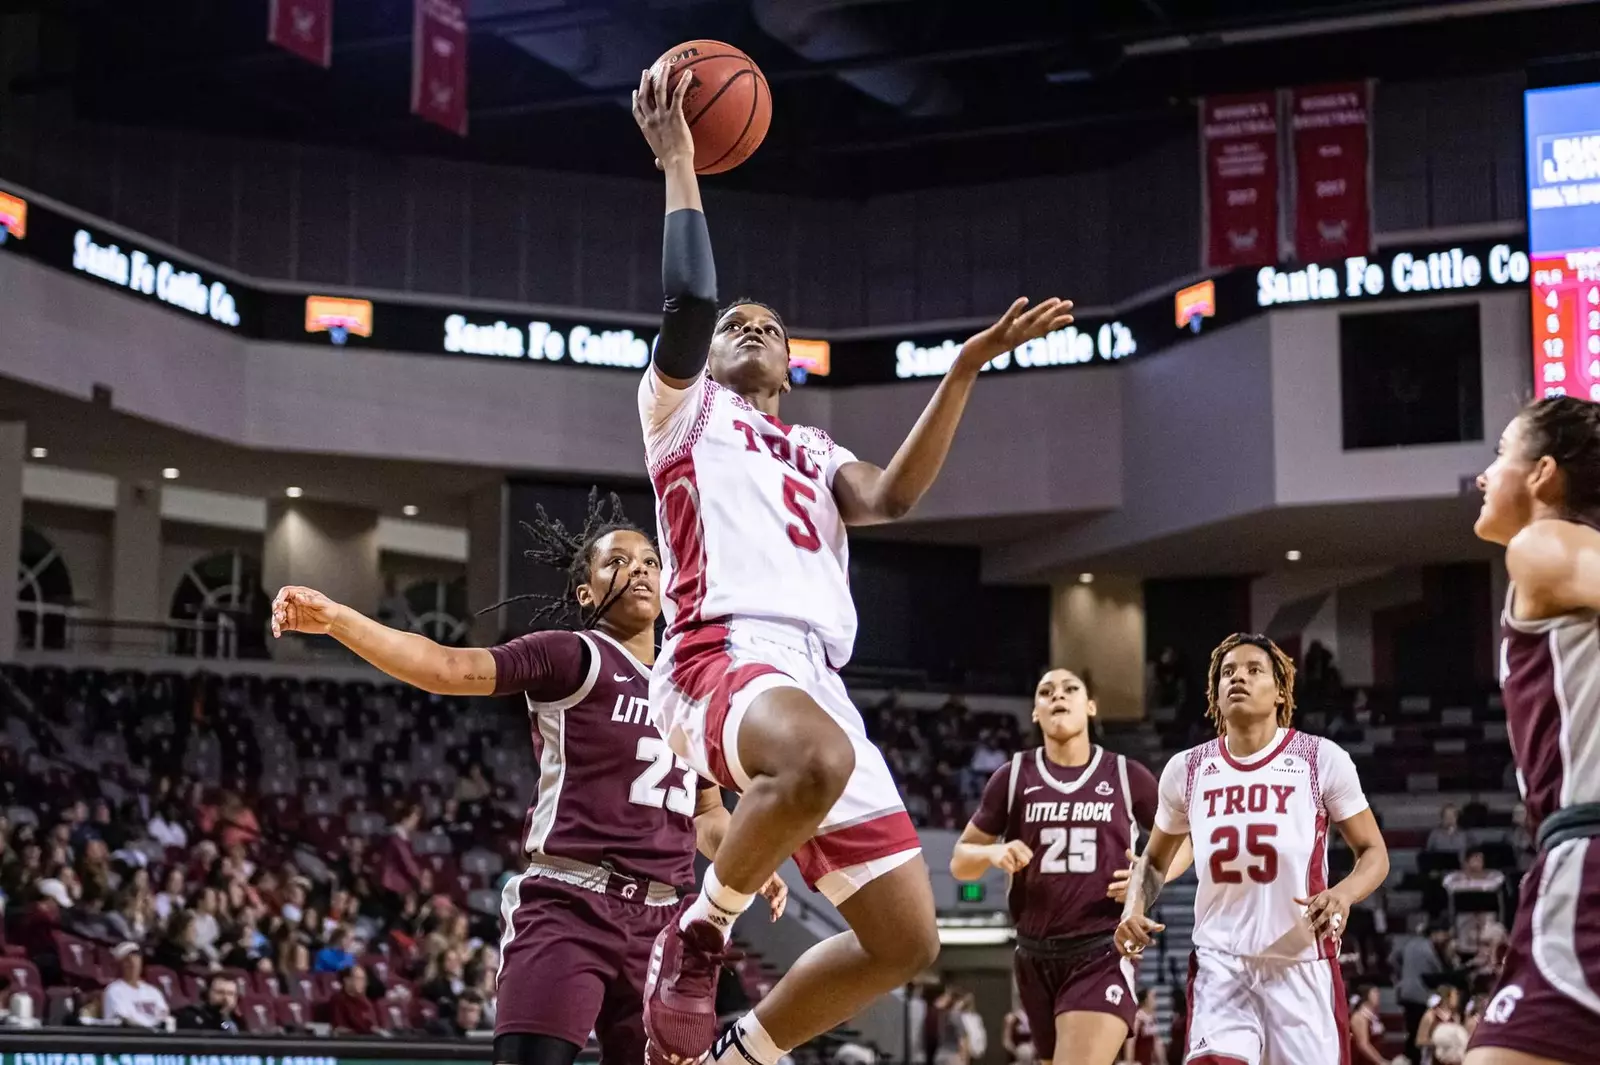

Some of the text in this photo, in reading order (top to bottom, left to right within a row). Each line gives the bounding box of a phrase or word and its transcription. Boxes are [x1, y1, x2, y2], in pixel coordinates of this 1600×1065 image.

[73, 229, 130, 286] Santa
[1257, 263, 1339, 306] Santa
[1345, 256, 1384, 297] Fe
[1391, 247, 1481, 292] Cattle
[444, 314, 525, 357] Santa
[528, 321, 565, 361] Fe
[568, 325, 649, 368] Cattle
[782, 473, 822, 554] 5
[611, 694, 657, 727] LITT
[628, 736, 698, 817] 23
[1203, 783, 1296, 818] TROY
[1025, 801, 1115, 823] LITTLE ROCK
[1040, 827, 1097, 874] 25
[1209, 823, 1278, 885] 25
